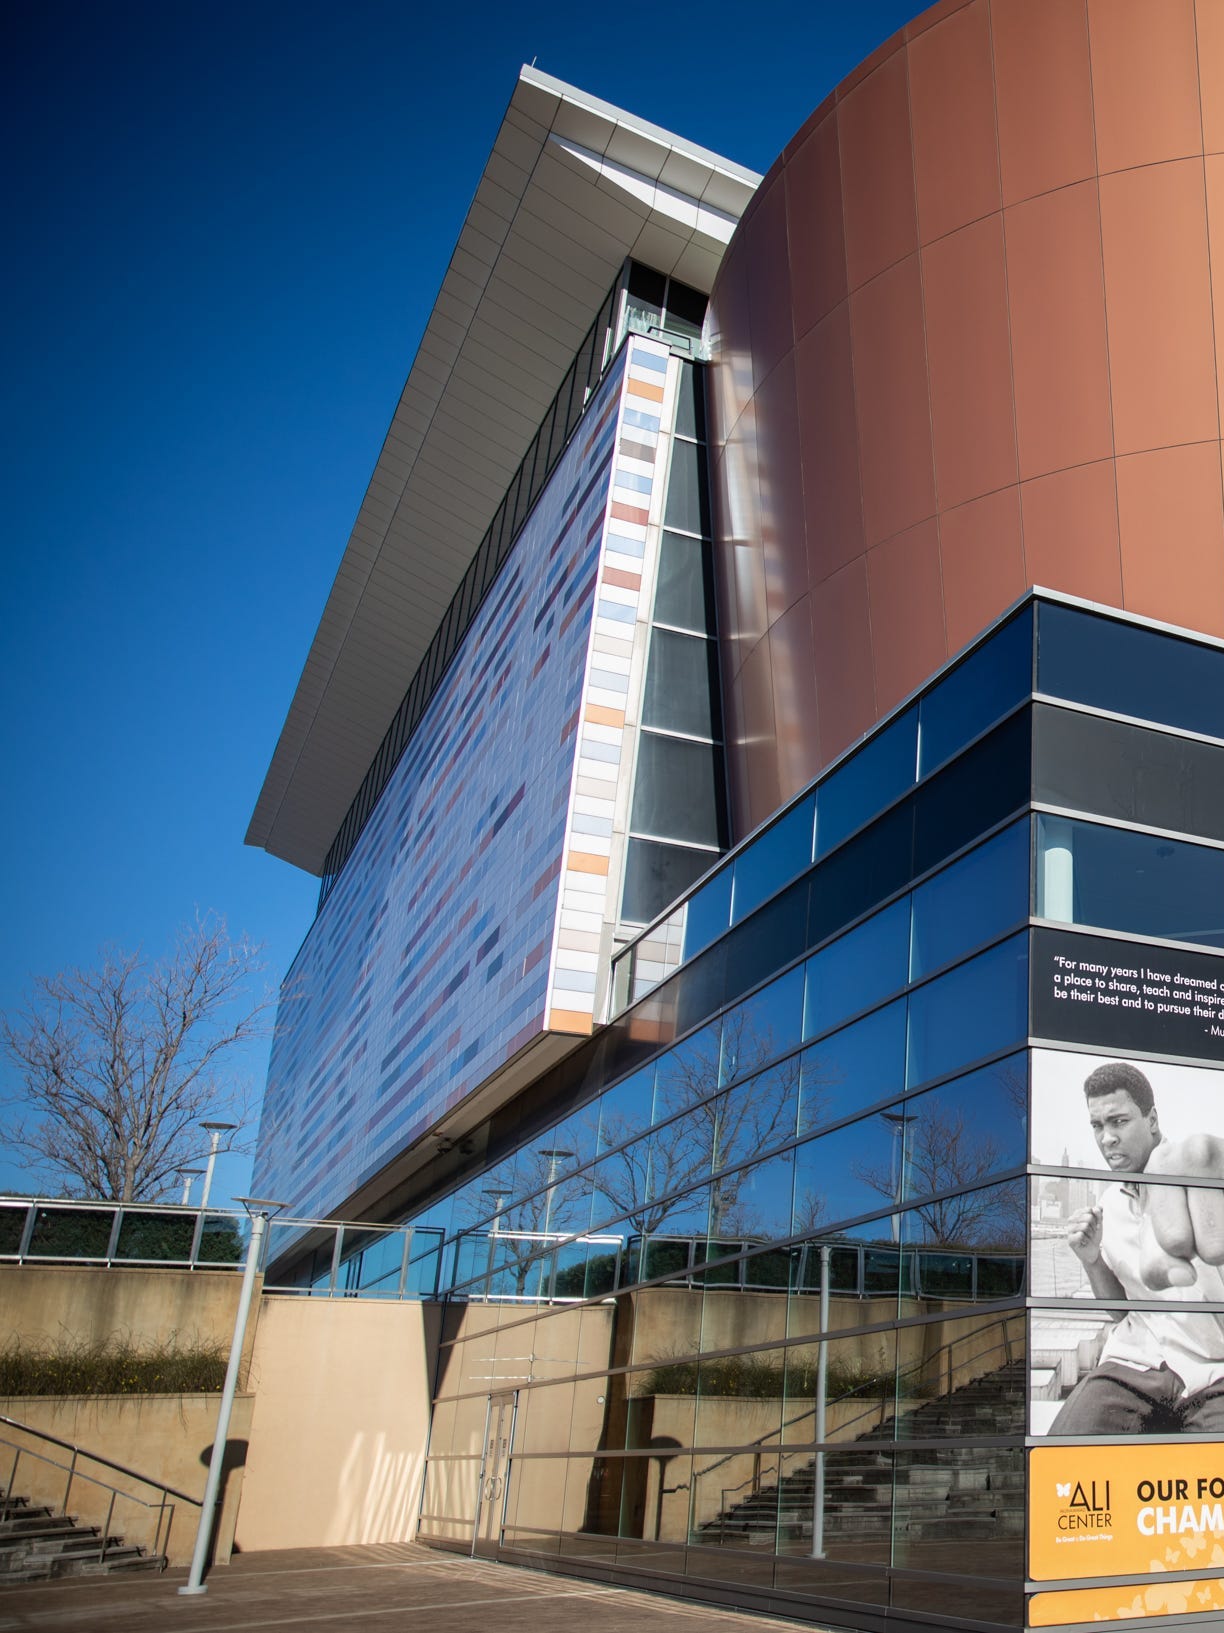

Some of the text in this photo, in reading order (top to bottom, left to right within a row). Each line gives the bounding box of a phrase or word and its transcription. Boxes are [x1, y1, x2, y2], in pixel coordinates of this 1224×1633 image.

[1054, 974, 1061, 983] a
[1064, 973, 1092, 986] place
[1095, 977, 1106, 988] to
[1108, 979, 1140, 995] share,
[1142, 984, 1170, 997] teach
[1173, 989, 1192, 1000] and
[1079, 962, 1108, 976] many
[1111, 967, 1138, 978] years
[1140, 968, 1144, 979] I
[1147, 968, 1171, 982] have
[1174, 973, 1217, 990] dreamed
[1054, 986, 1068, 999] be
[1070, 988, 1095, 1002] their
[1097, 992, 1119, 1005] best
[1122, 997, 1142, 1008] and
[1144, 999, 1155, 1010] to
[1157, 1003, 1191, 1014] pursue
[1193, 1005, 1216, 1019] their
[1070, 1480, 1110, 1511] ALI
[1137, 1479, 1188, 1502] OUR
[1058, 1513, 1112, 1530] CENTER
